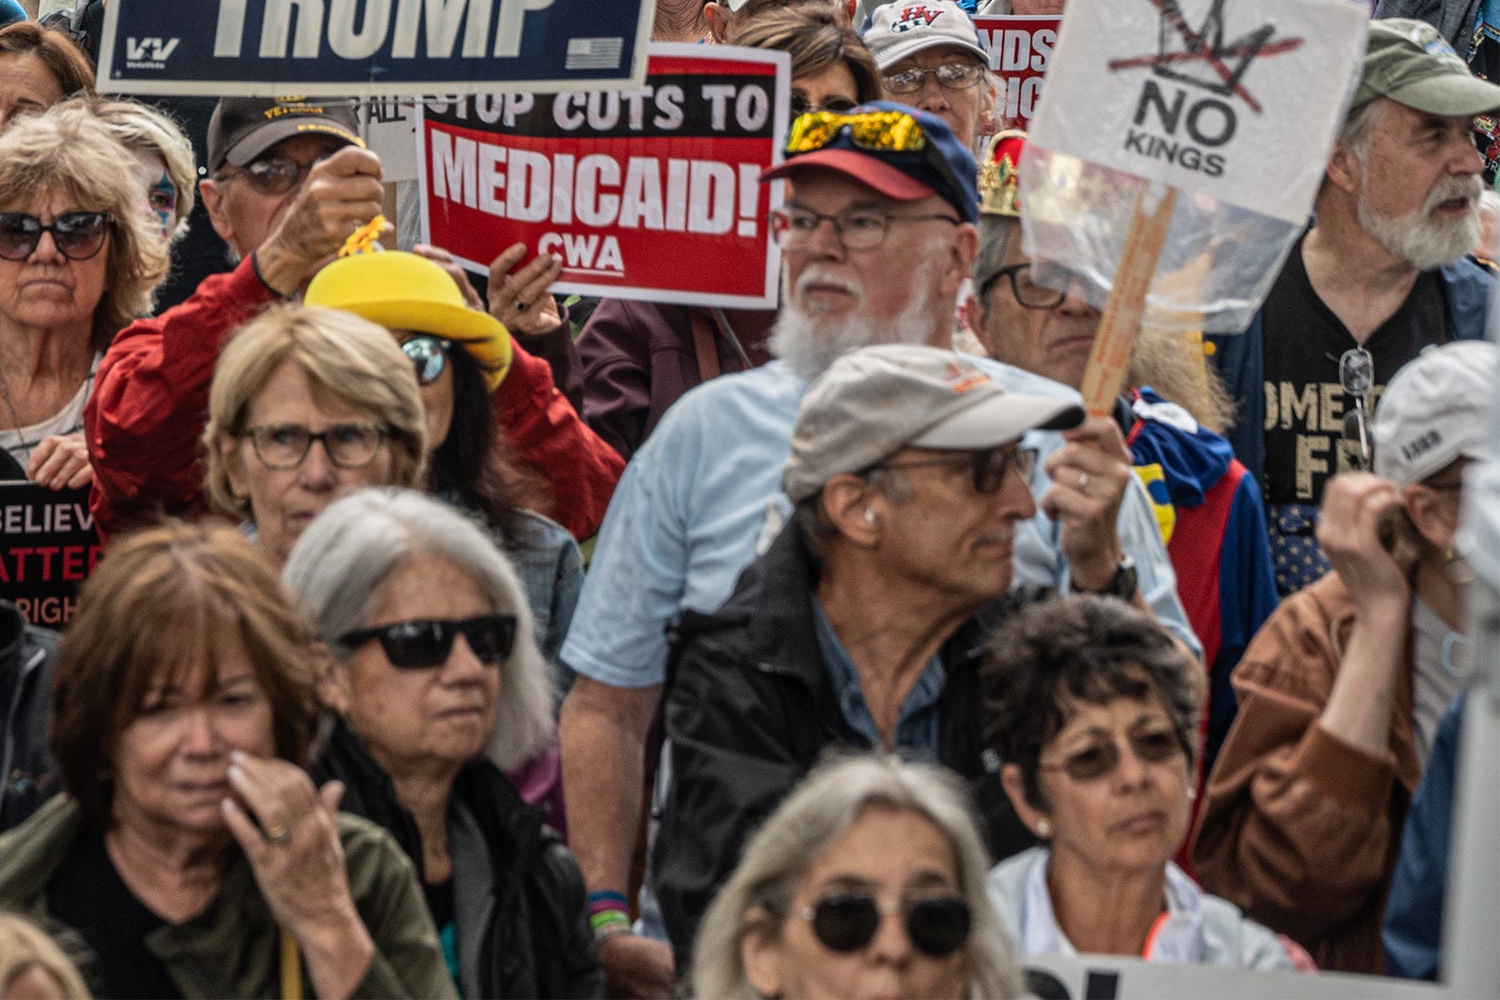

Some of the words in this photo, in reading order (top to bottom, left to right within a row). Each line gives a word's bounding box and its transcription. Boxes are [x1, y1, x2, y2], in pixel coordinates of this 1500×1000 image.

[978, 29, 1057, 72] NDS
[368, 95, 406, 124] ALL
[552, 85, 684, 131] CUTS
[701, 84, 769, 132] TO
[1134, 79, 1237, 147] NO
[1124, 128, 1225, 177] KINGS
[431, 129, 760, 238] MEDICAID!
[537, 232, 624, 271] CWA
